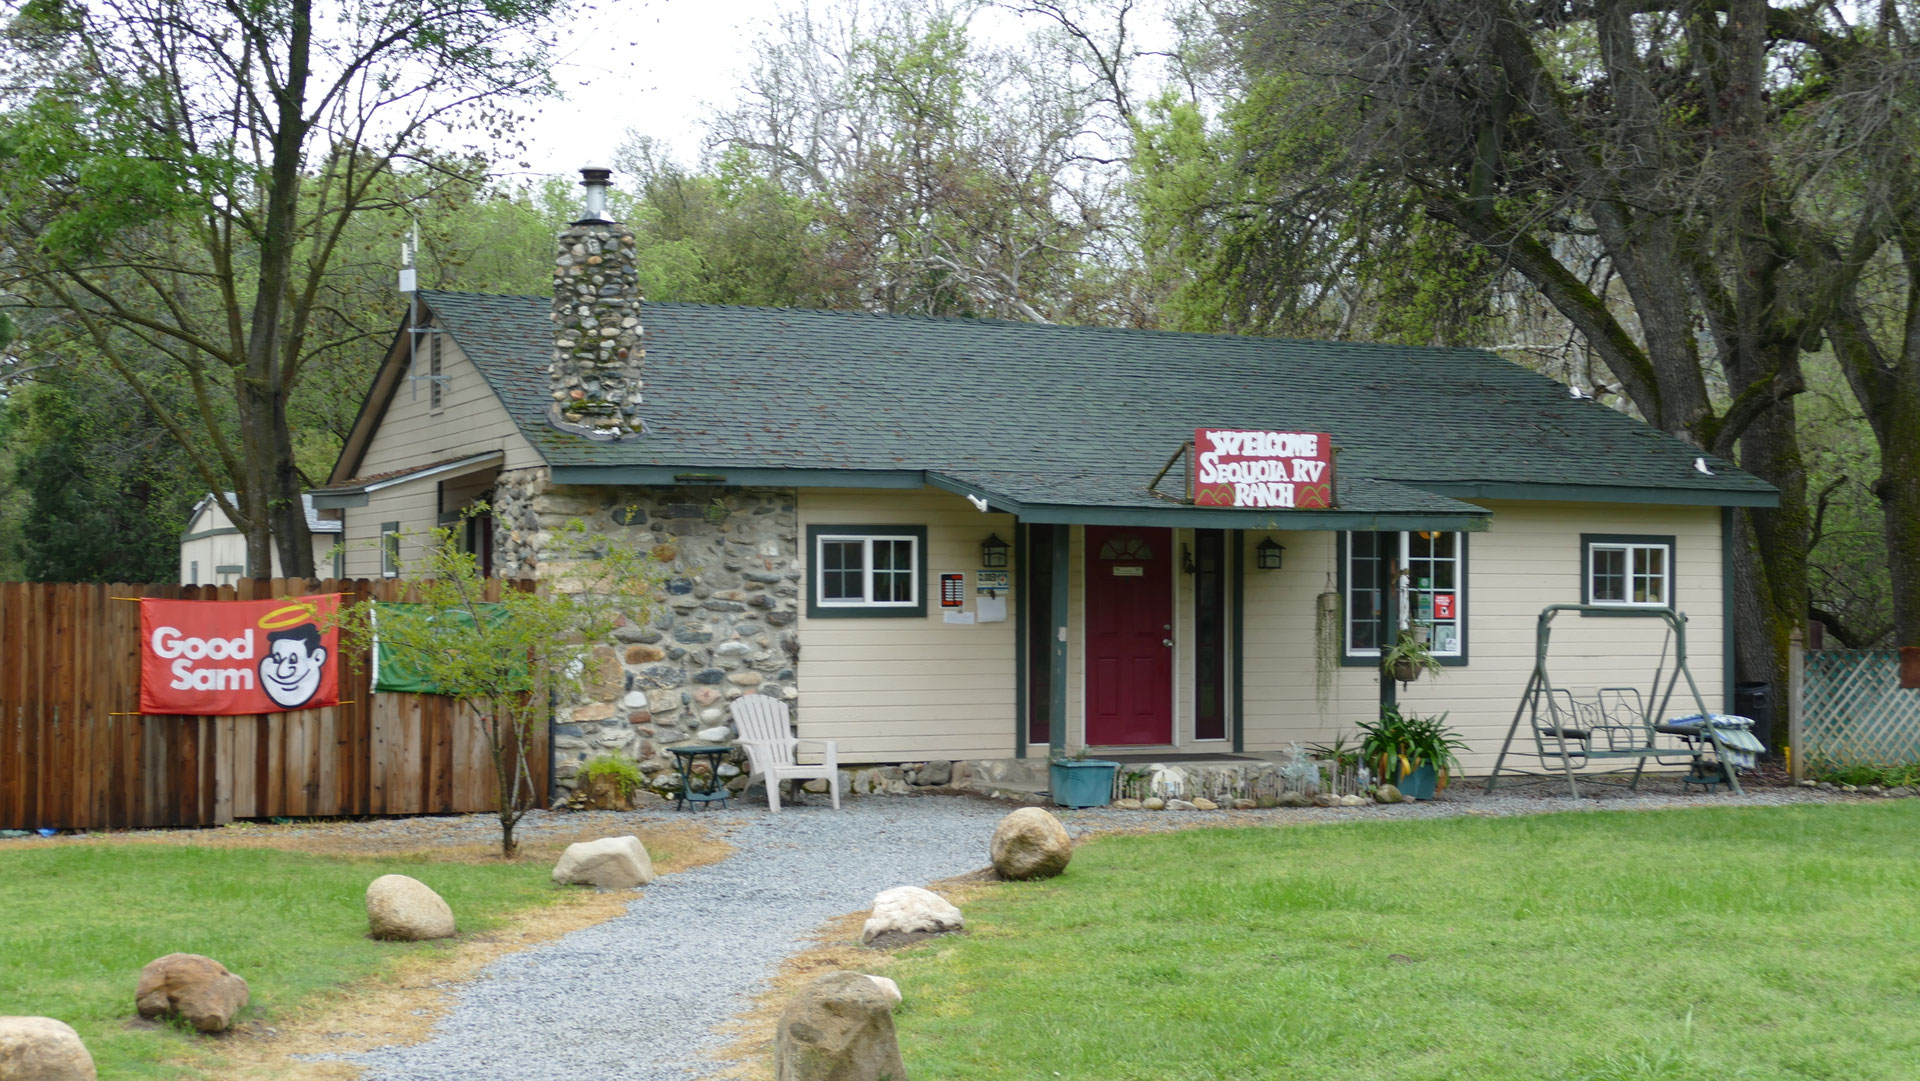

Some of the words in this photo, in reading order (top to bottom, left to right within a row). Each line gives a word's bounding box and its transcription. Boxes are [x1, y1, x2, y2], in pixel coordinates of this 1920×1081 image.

[1206, 431, 1318, 458] WELCOME
[1199, 452, 1290, 484] SEQUOIA
[1291, 458, 1326, 483] RV
[1233, 483, 1295, 507] RANCH
[152, 626, 254, 660] Good
[170, 659, 254, 690] Sam
